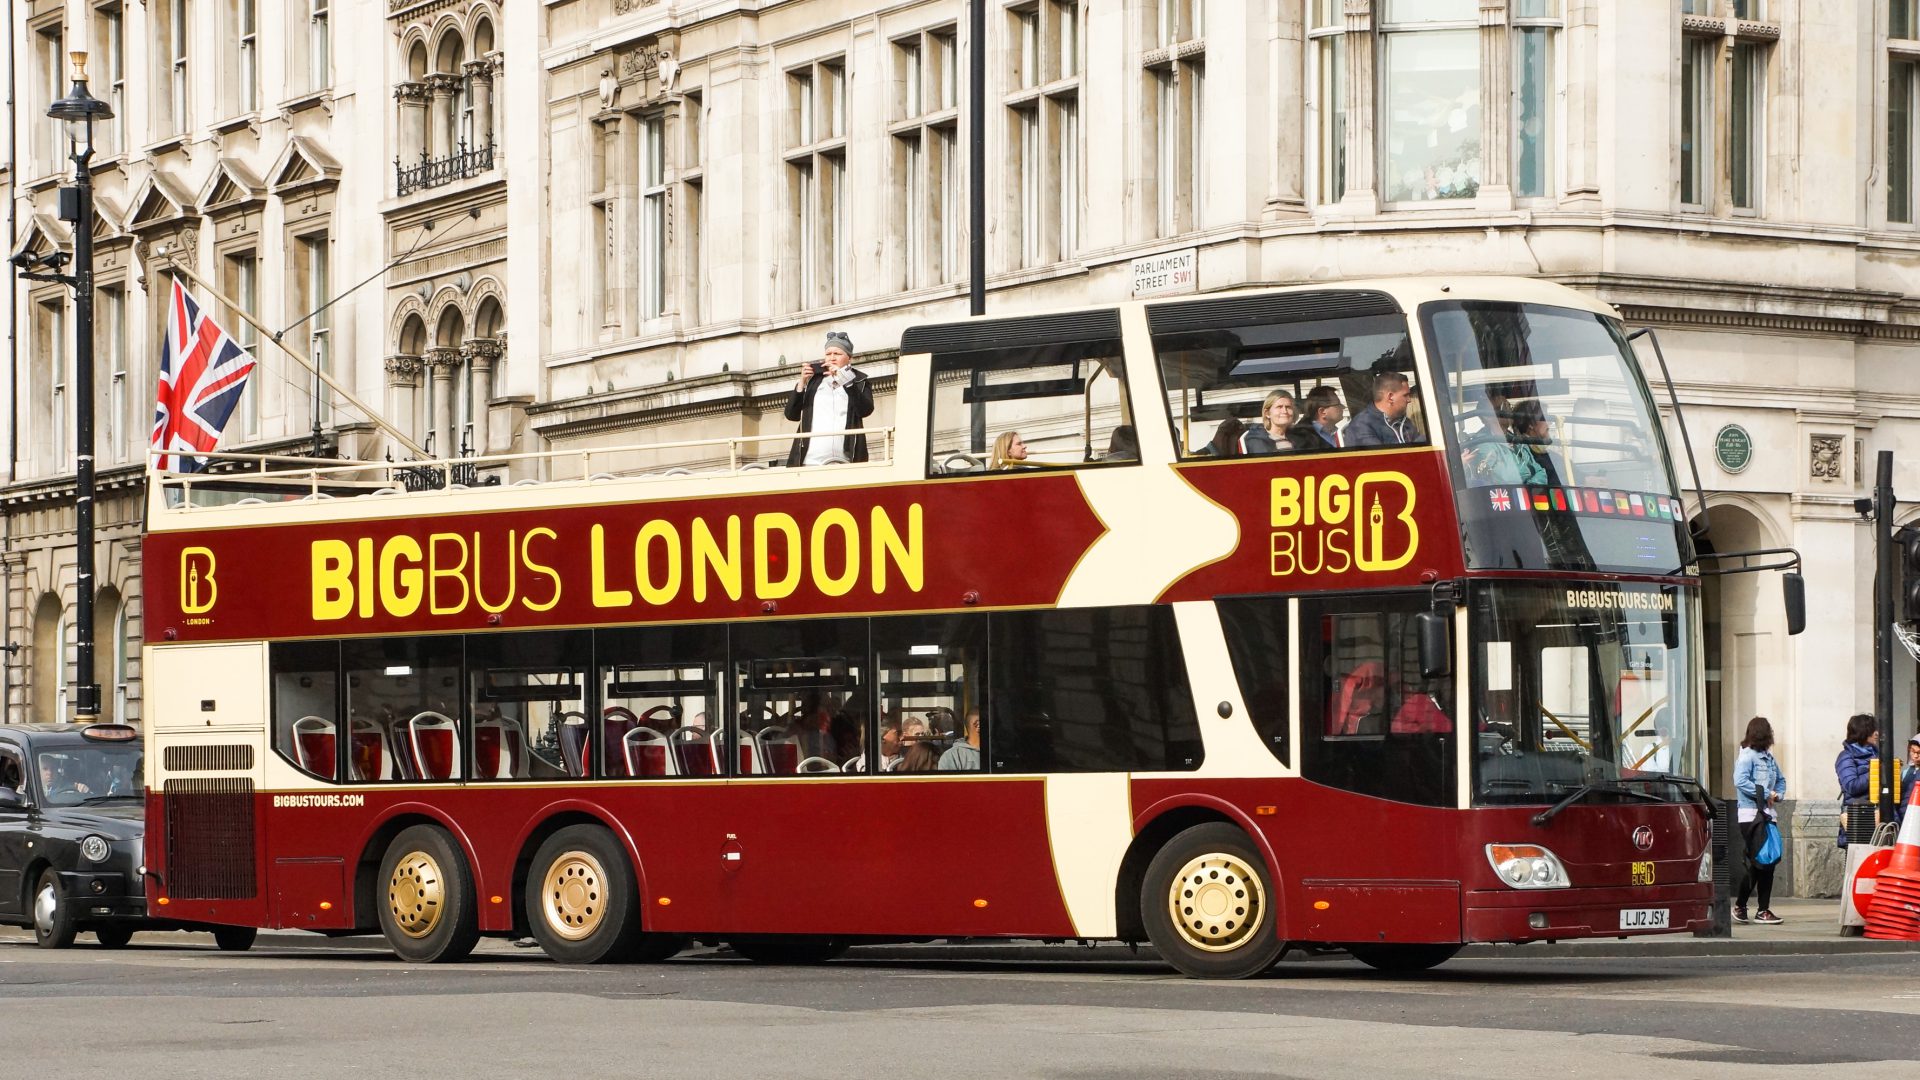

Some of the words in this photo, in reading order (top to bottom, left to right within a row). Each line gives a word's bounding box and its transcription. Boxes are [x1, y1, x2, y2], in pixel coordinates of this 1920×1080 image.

[1135, 255, 1191, 276] PARLIAMENT
[1135, 274, 1168, 291] STREET
[1173, 270, 1191, 284] SW1
[1270, 473, 1350, 527] BIG
[591, 503, 924, 608] LONDON
[1270, 528, 1351, 576] BUS
[1566, 590, 1673, 611] BIGBUSTOURS.COM
[273, 794, 364, 808] BIGBUSTOURS.COM
[1632, 861, 1645, 875] BIG
[1632, 874, 1645, 886] BUS
[1626, 911, 1647, 926] LJ12
[1648, 910, 1665, 925] JSX
